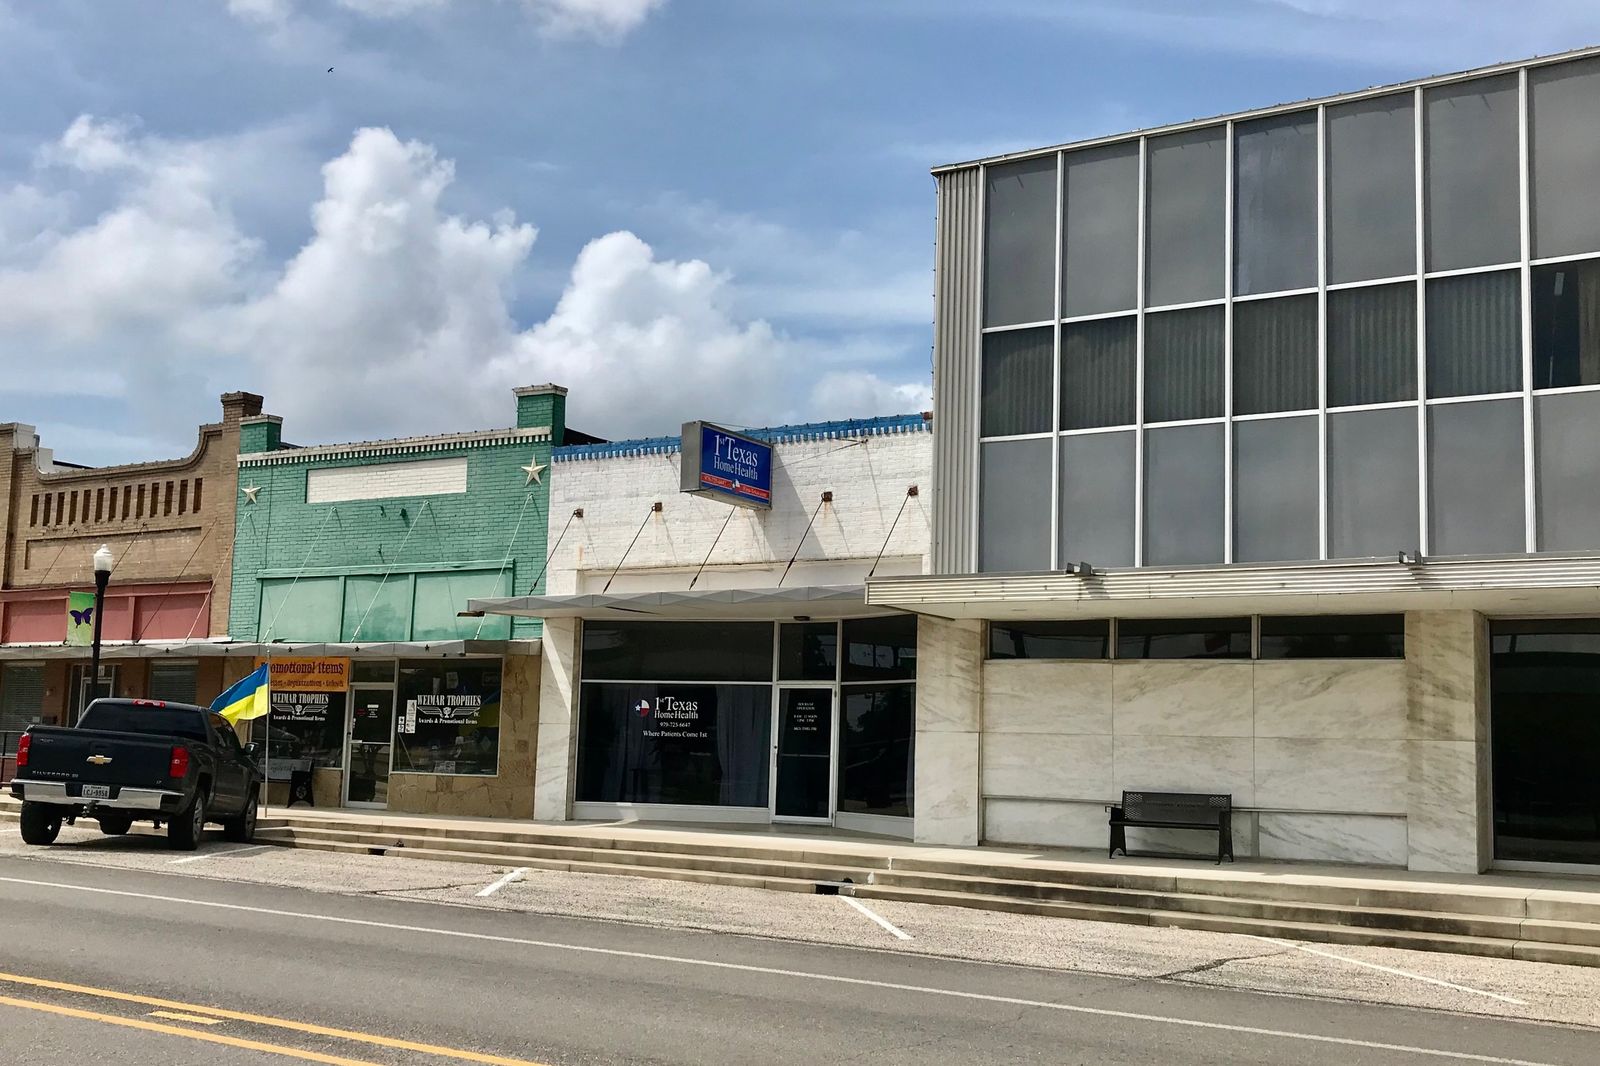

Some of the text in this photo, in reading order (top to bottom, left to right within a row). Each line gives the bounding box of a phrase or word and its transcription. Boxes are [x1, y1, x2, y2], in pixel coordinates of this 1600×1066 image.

[725, 436, 758, 468] Texas
[261, 661, 315, 674] omotional
[272, 693, 329, 704] WEIMAR TROPHIES
[417, 695, 481, 706] WEIMAR TROPHIES
[664, 696, 698, 711] Texas
